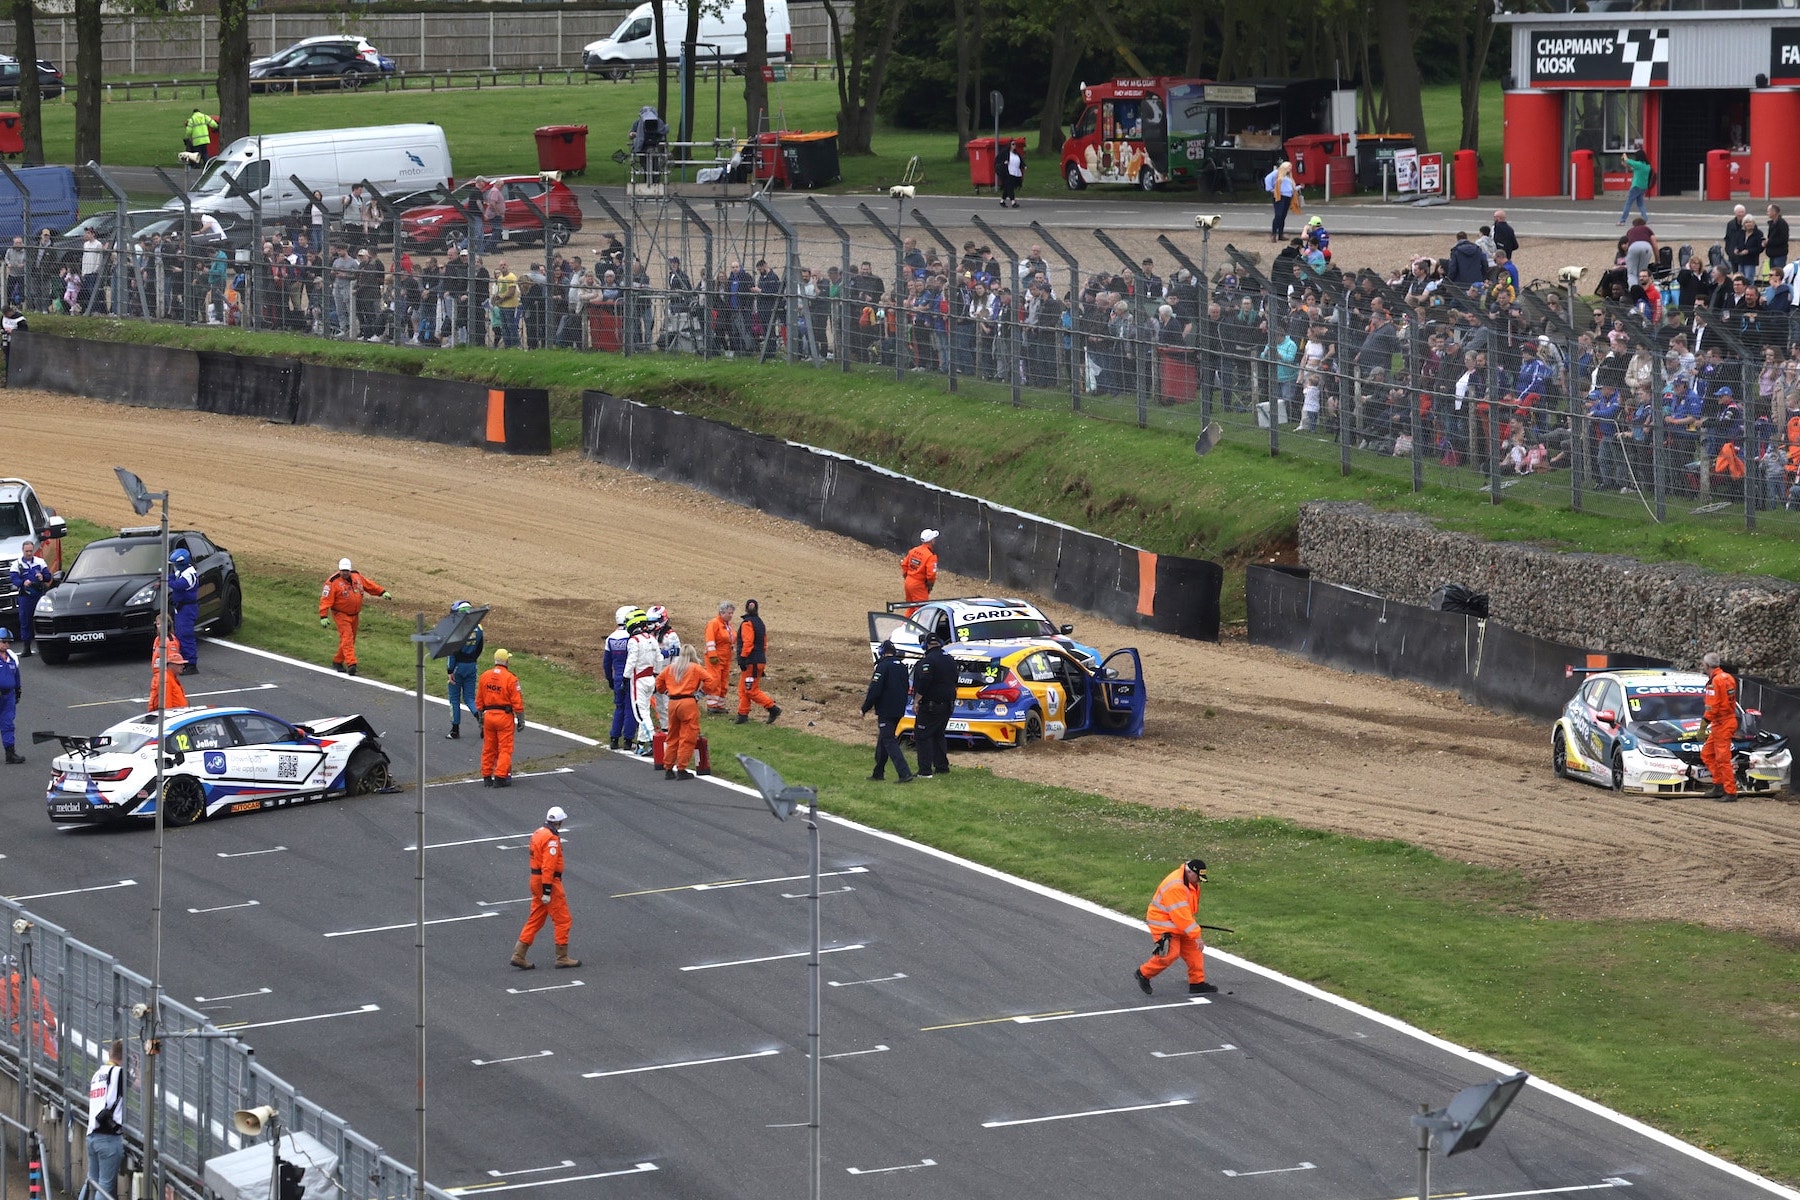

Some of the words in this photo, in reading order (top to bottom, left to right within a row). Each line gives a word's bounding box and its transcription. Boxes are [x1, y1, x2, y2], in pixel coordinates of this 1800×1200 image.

[1537, 38, 1614, 54] CHAPMAN'S
[1781, 45, 1800, 64] FA
[1536, 57, 1575, 73] KIOSK
[70, 632, 104, 642] DOCTOR
[957, 627, 970, 638] 33
[985, 665, 999, 678] 32
[1636, 685, 1708, 694] CarStor
[1629, 698, 1641, 708] 11
[176, 734, 190, 750] 12
[196, 739, 218, 749] Jelley
[56, 803, 81, 812] metclad
[230, 801, 261, 813] AUTOCAR
